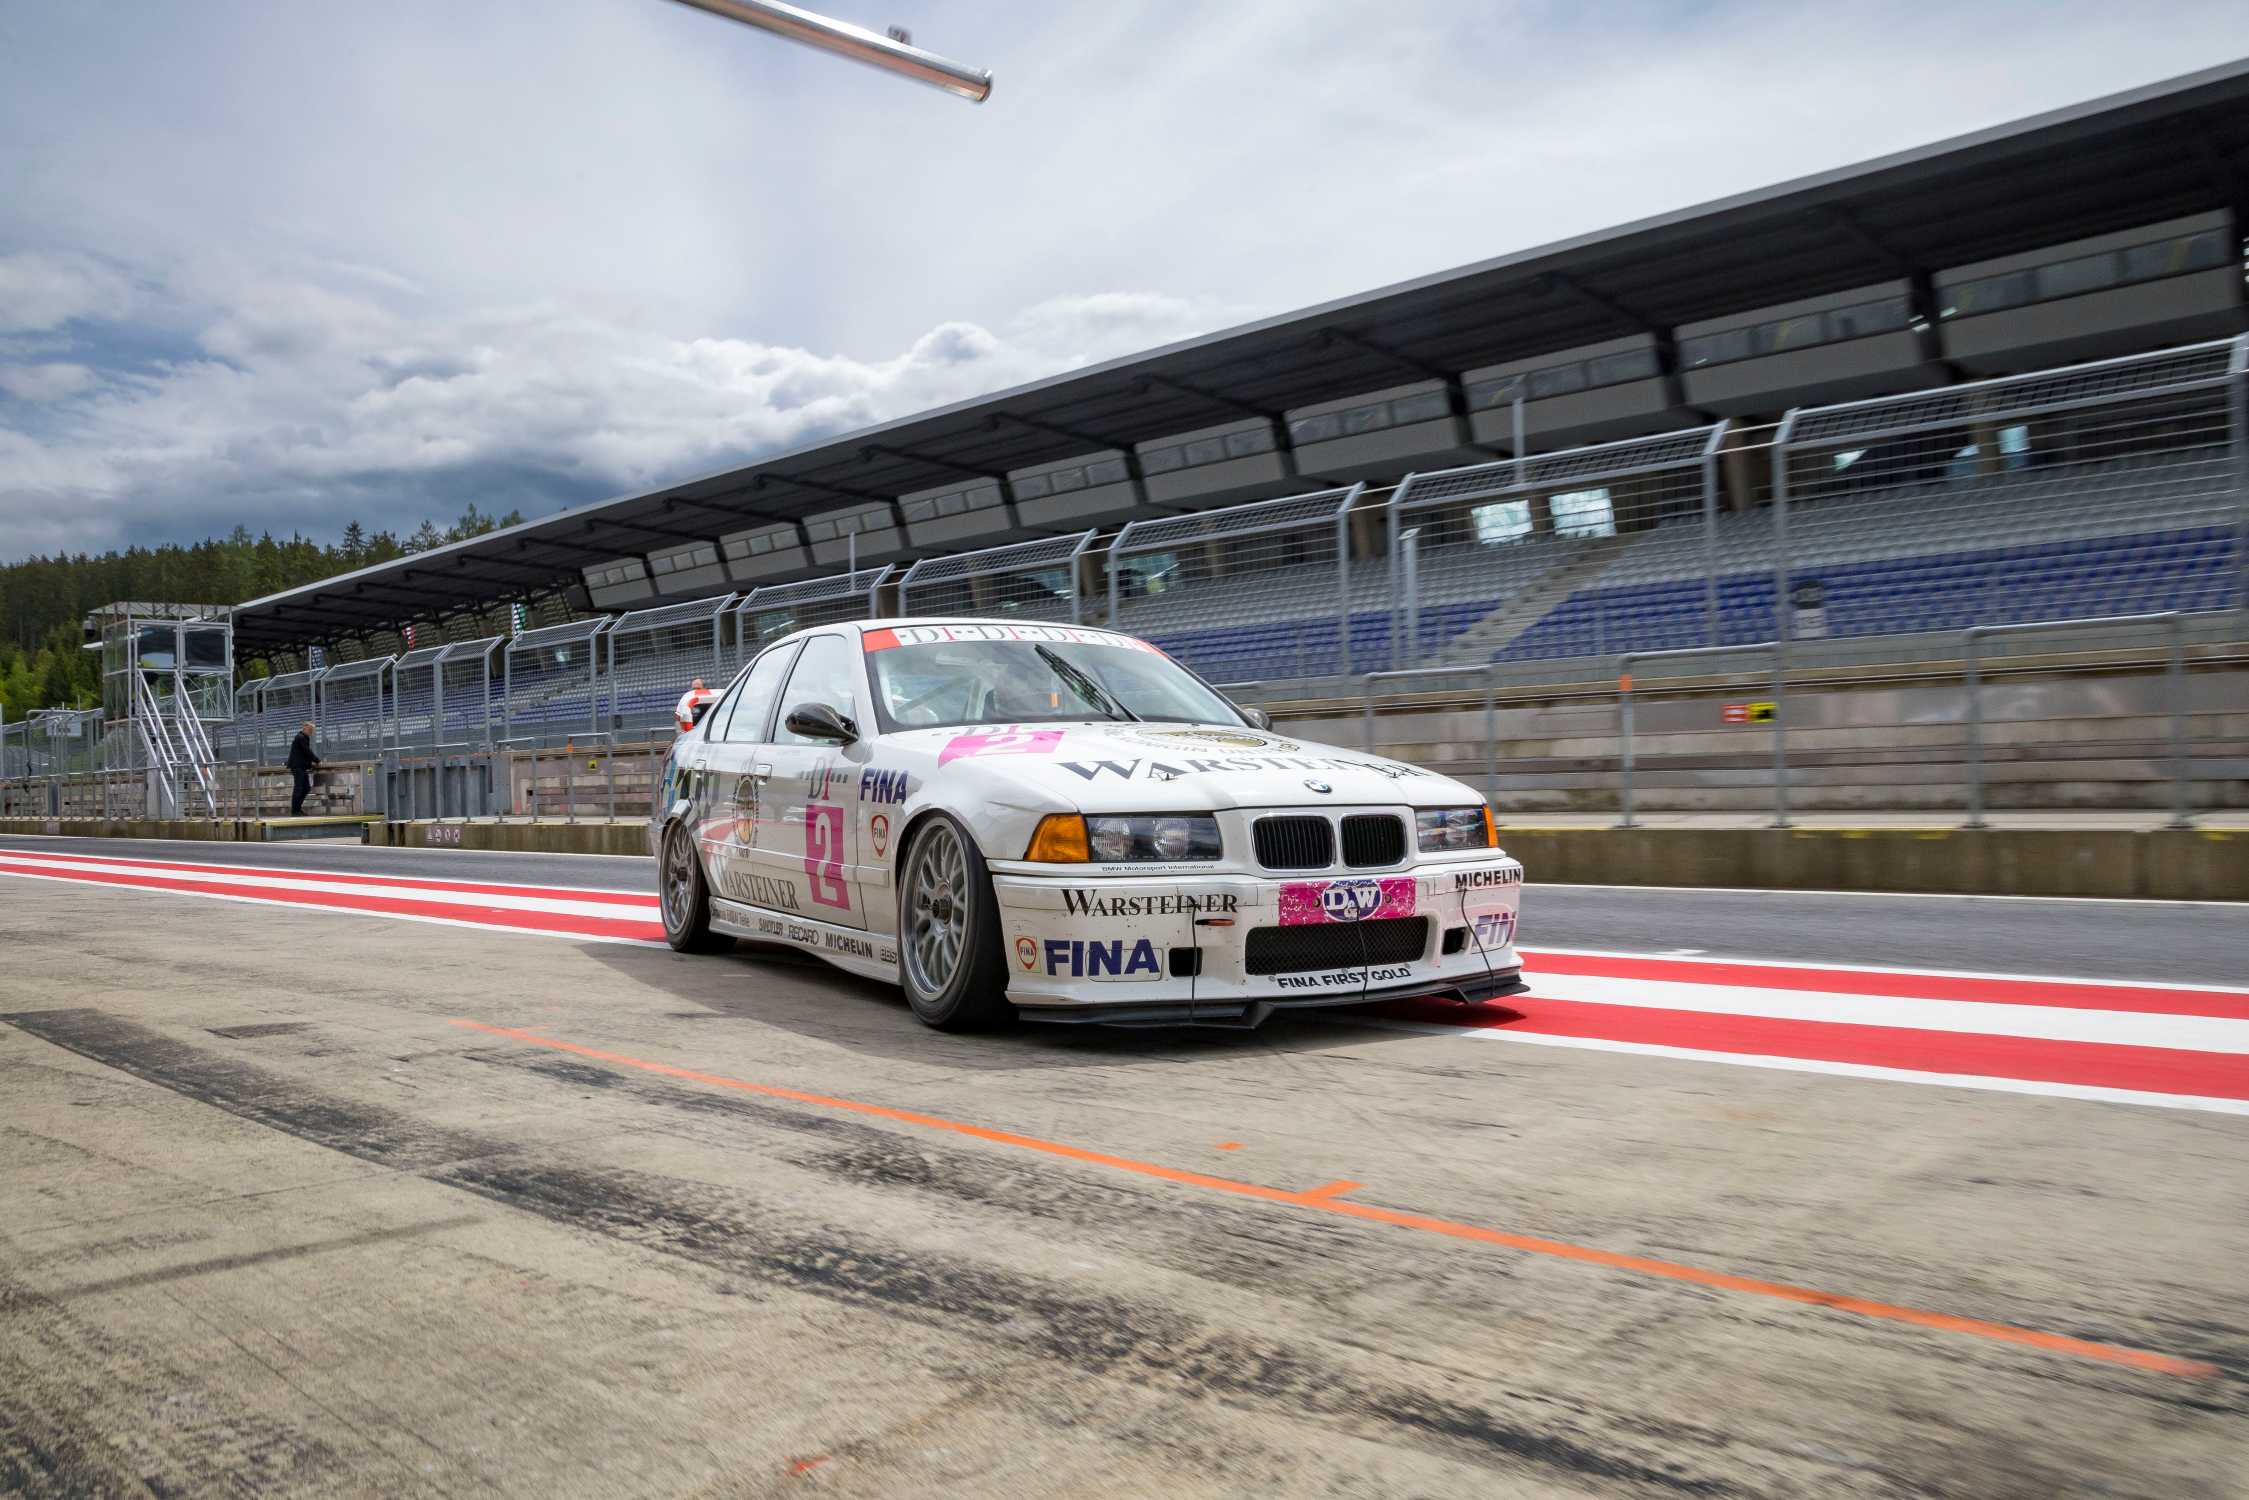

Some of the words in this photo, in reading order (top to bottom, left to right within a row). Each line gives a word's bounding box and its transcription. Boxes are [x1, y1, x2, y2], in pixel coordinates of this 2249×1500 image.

[860, 768, 909, 805] FINA
[873, 823, 886, 839] FINA
[815, 812, 840, 901] 2
[1124, 865, 1166, 873] Motorsport
[1455, 868, 1521, 889] MICHELIN
[719, 870, 801, 910] WARSTEINER
[1061, 889, 1238, 916] WARSTEINER
[788, 924, 820, 946] RECARO
[825, 931, 873, 959] MICHELIN
[1019, 946, 1034, 957] FINA
[1044, 939, 1160, 977] FINA
[1277, 977, 1321, 988] FINA
[1322, 972, 1368, 985] FIRST
[1372, 967, 1411, 981] GOLD
